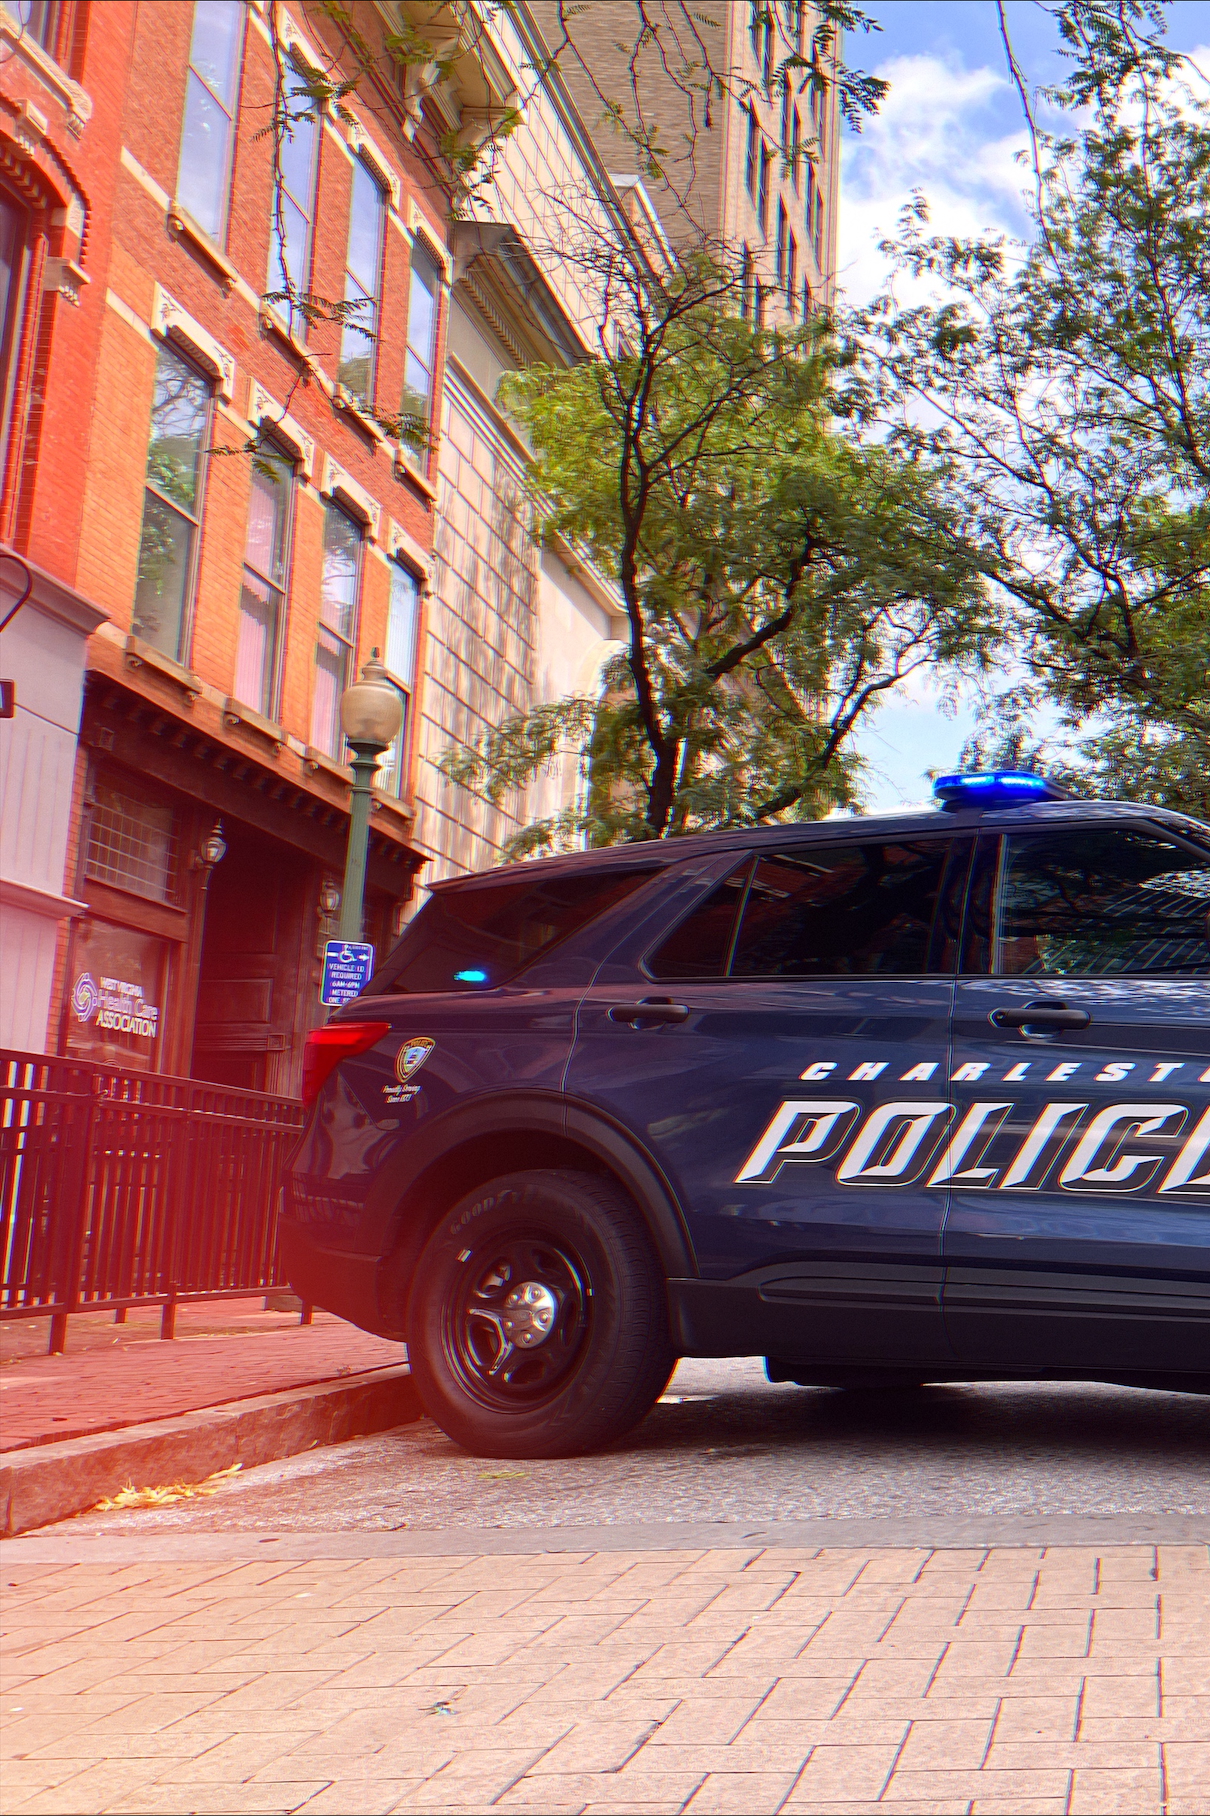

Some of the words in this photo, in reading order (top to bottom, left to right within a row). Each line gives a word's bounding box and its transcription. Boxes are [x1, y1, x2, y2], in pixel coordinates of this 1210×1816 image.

[329, 962, 356, 972] VEHICLE
[331, 970, 362, 980] REQUIRED
[332, 980, 360, 989] 6AM-6PM
[331, 988, 359, 998] METERED
[97, 989, 132, 1015] Health
[134, 998, 159, 1021] Care
[328, 996, 341, 1004] ONE
[95, 1009, 158, 1038] ASSOCIATION
